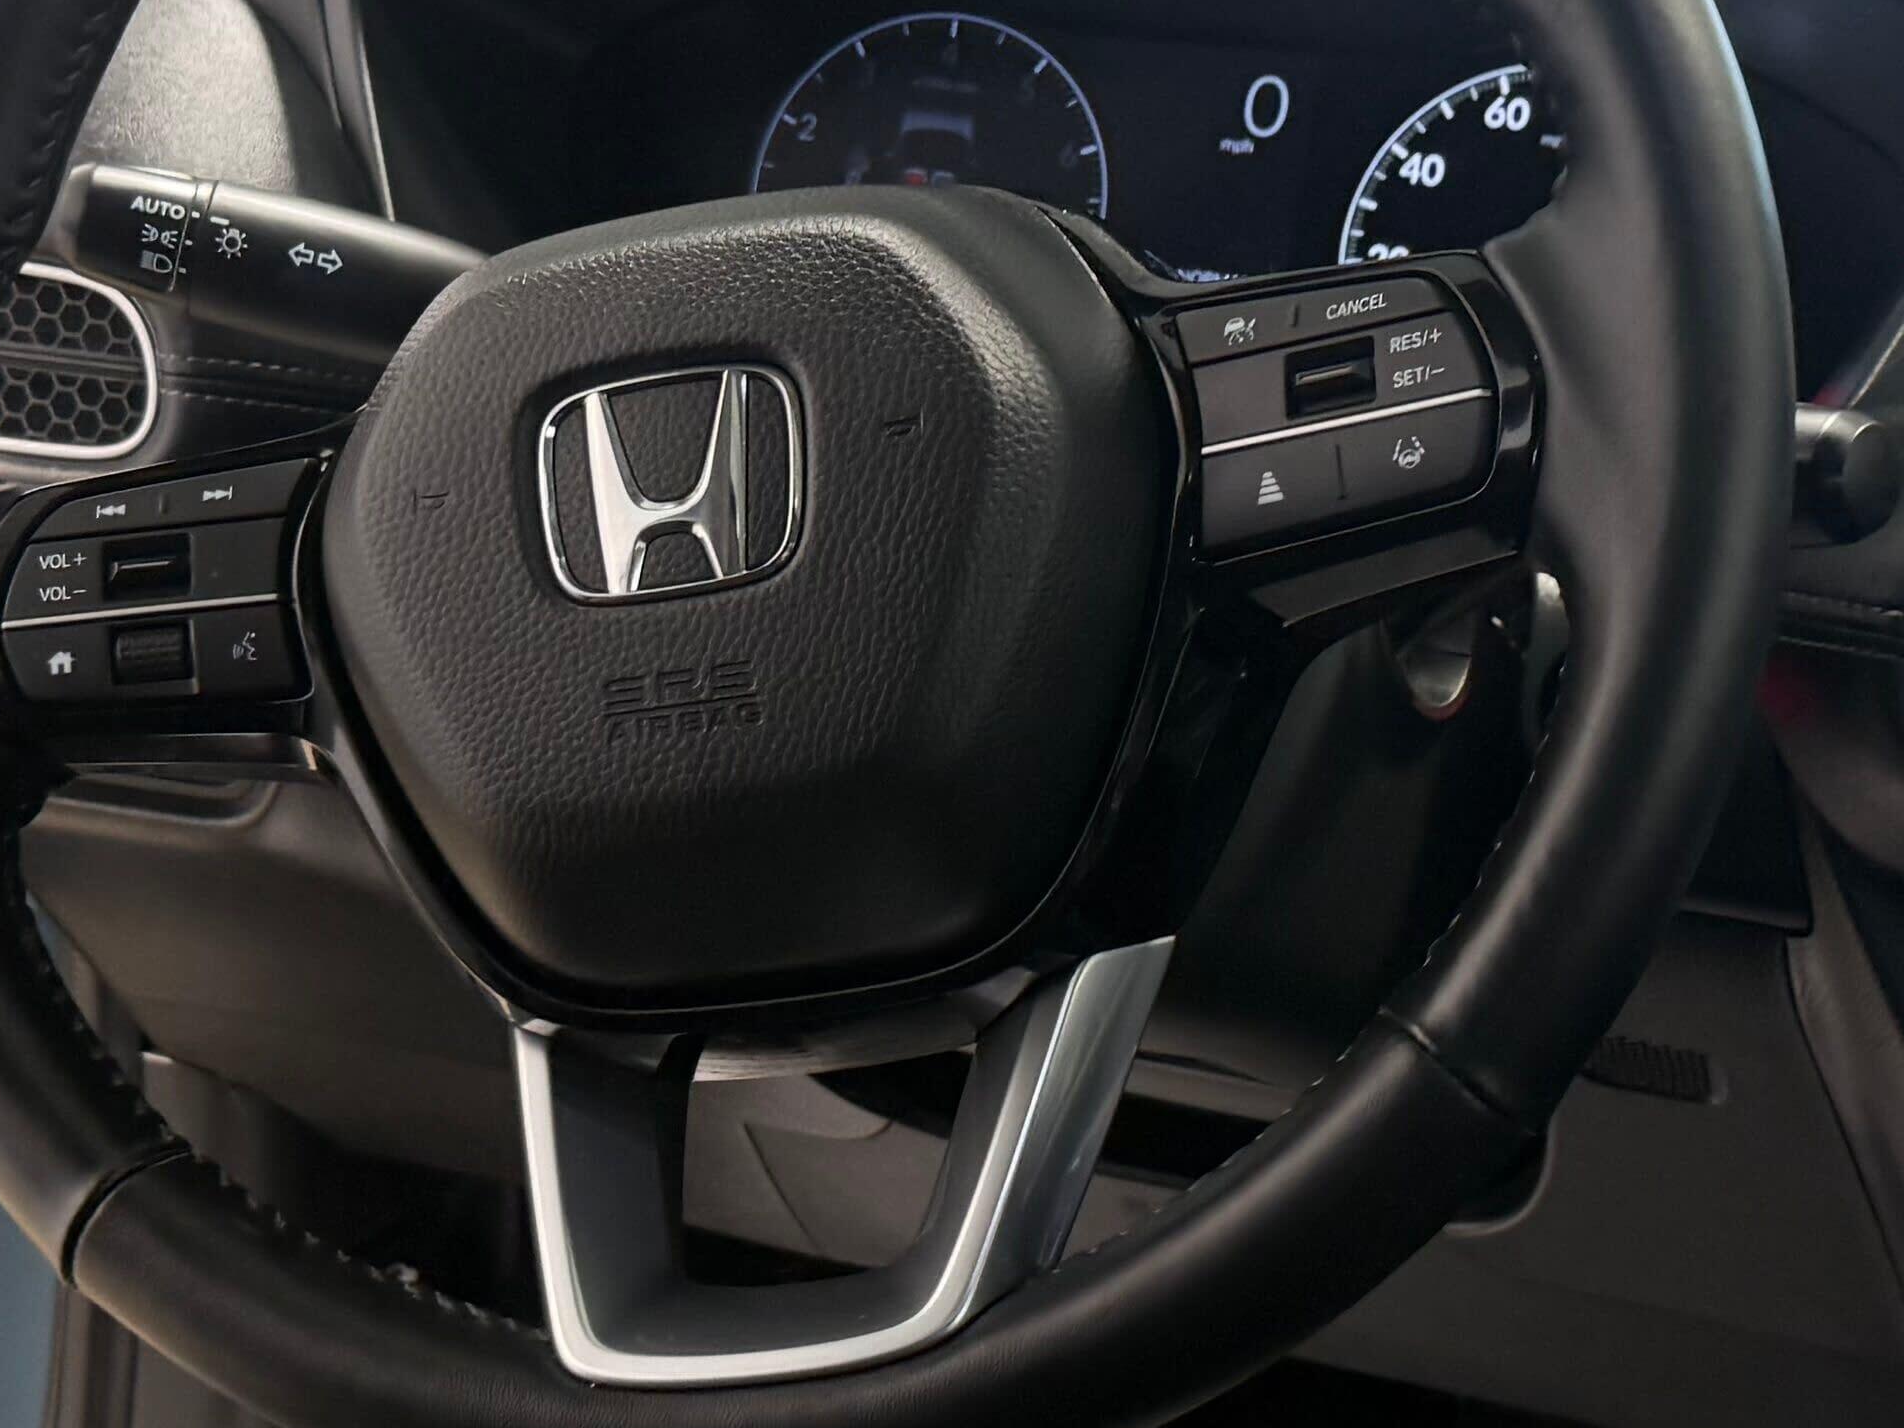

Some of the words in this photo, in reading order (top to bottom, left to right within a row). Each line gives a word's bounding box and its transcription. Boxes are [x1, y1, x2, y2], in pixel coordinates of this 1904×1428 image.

[1483, 95, 1531, 132] 60
[1218, 137, 1255, 156] mph
[1398, 152, 1446, 188] 40
[129, 194, 187, 221] AUTO
[1325, 292, 1389, 320] CANCEL
